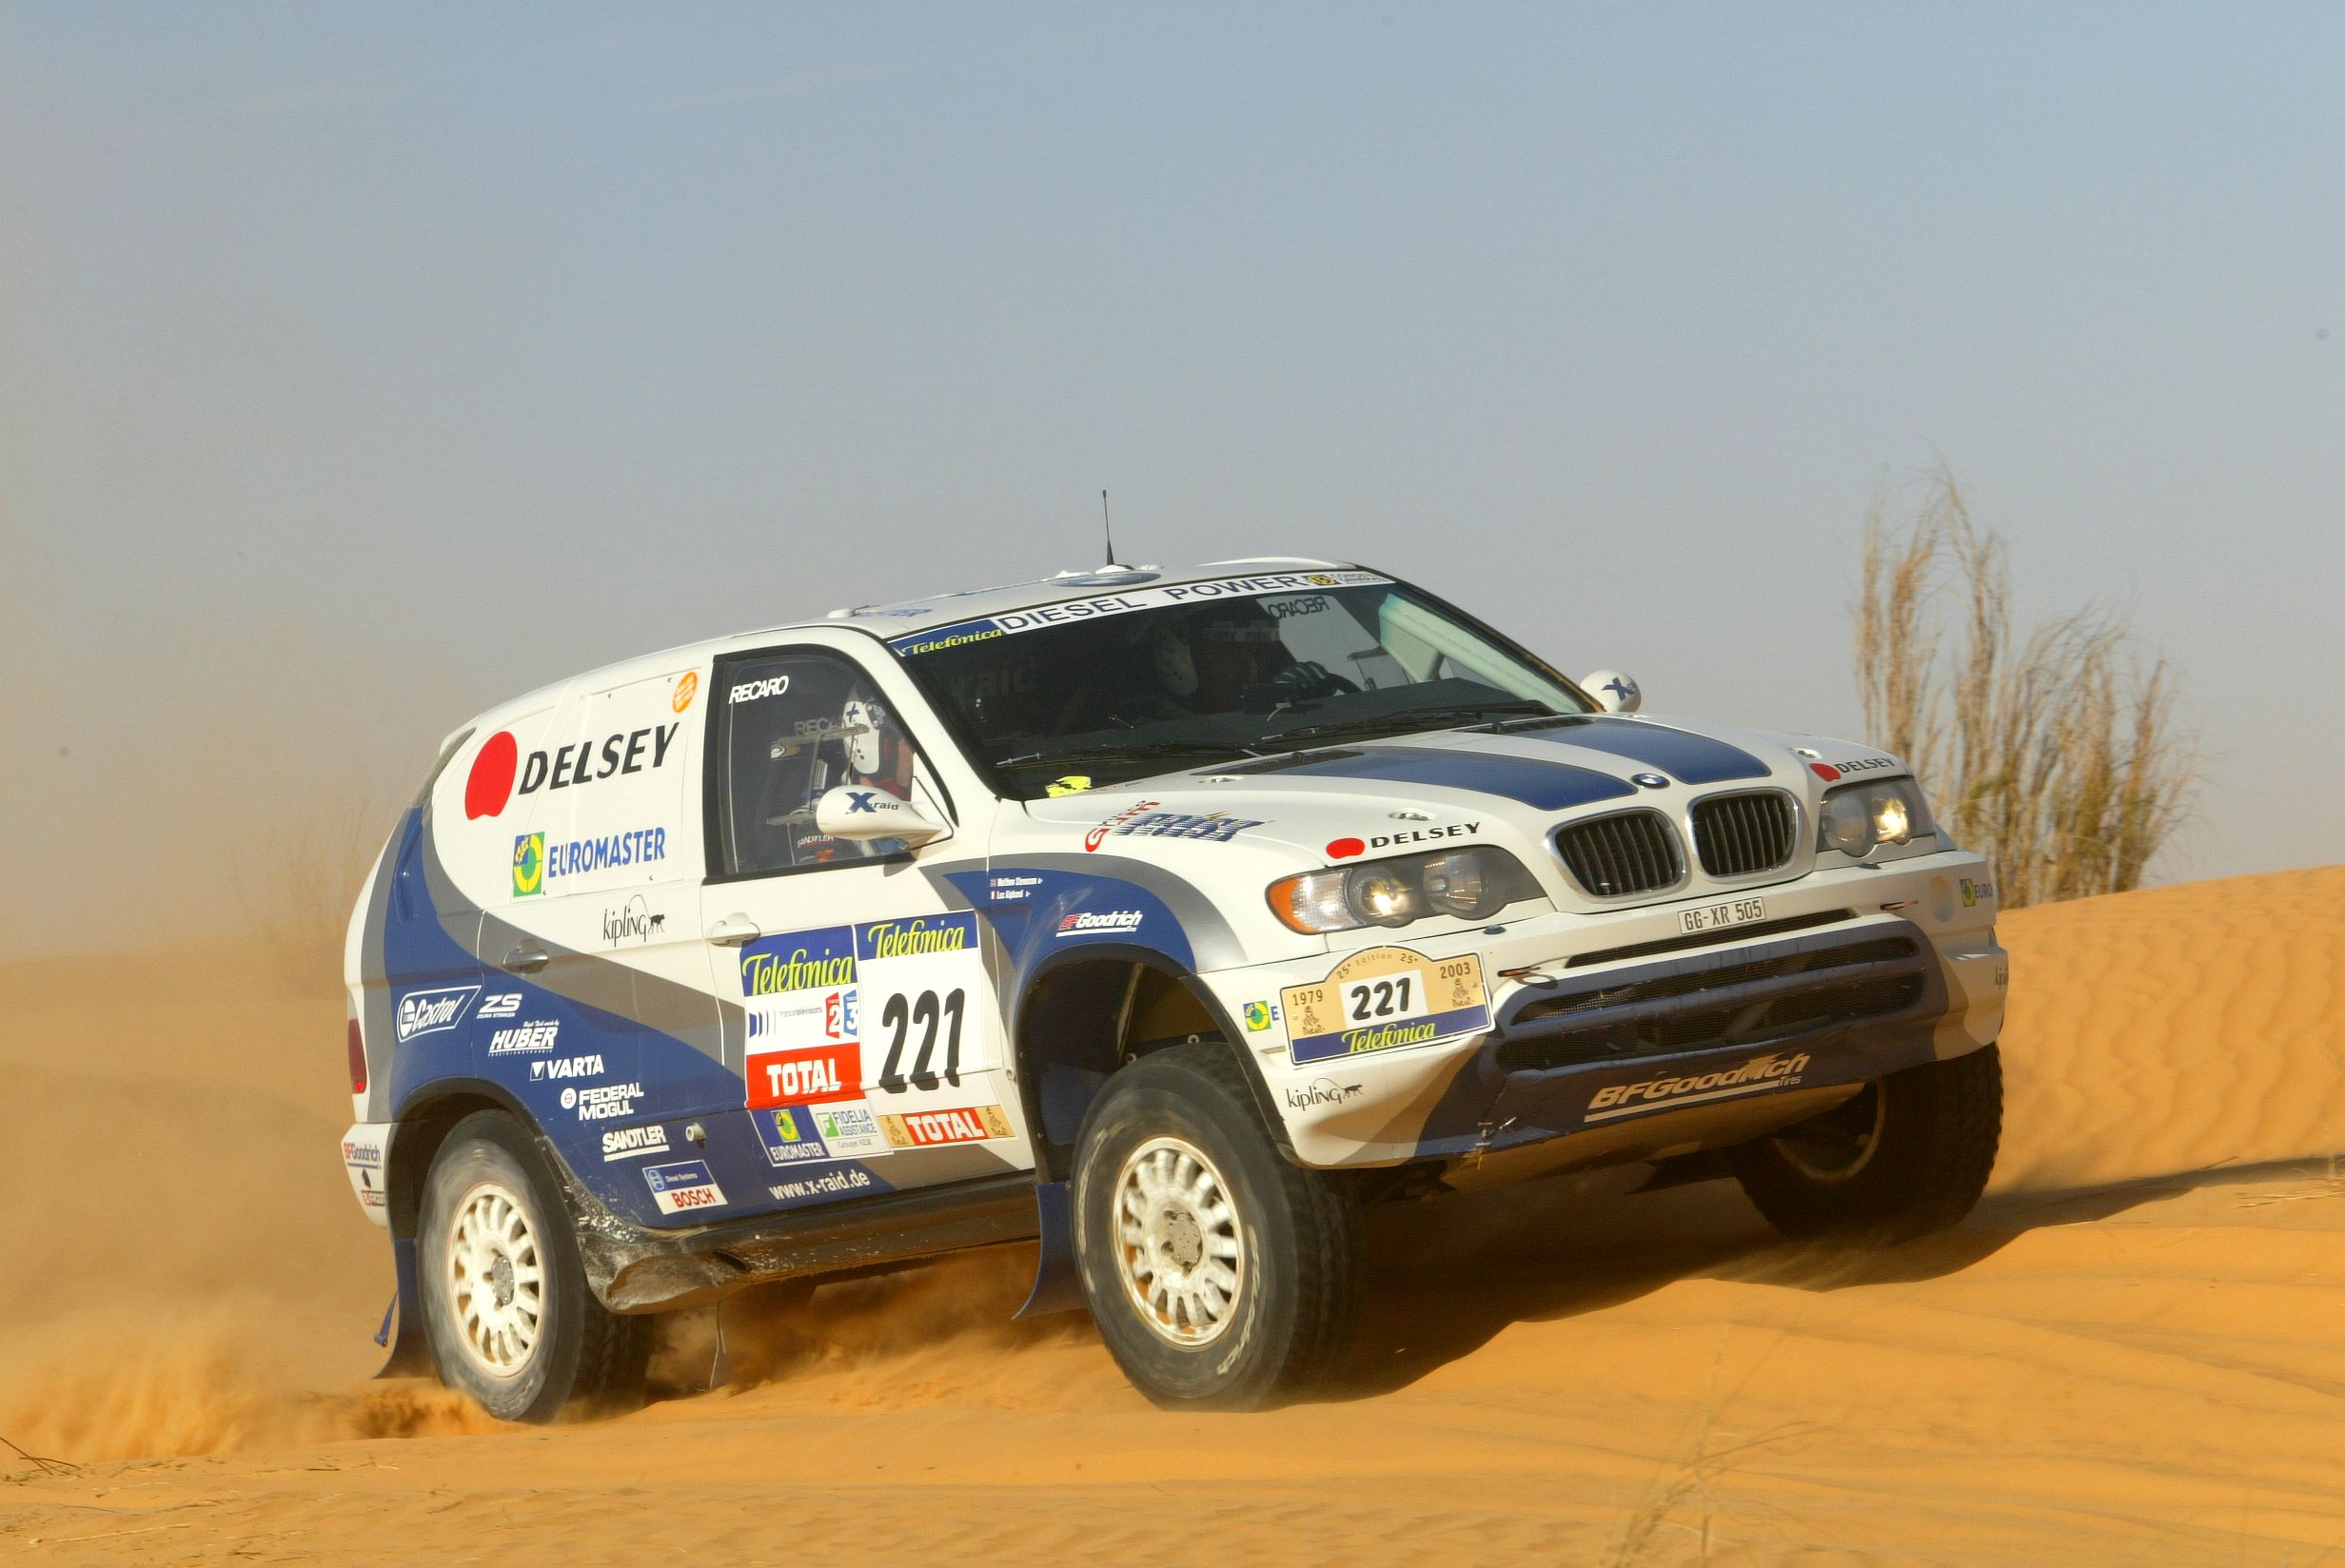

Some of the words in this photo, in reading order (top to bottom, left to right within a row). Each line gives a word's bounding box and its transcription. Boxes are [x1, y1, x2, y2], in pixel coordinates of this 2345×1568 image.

[999, 597, 1147, 631] DIESEL
[1162, 574, 1308, 601] POWER
[728, 676, 790, 705] RECARO
[518, 721, 680, 795] DELSEY
[1833, 756, 1897, 774] DELSEY
[1370, 821, 1481, 850] DELSEY
[548, 827, 666, 878] EUROMASTER
[1058, 910, 1143, 931] BFGoodrich
[1735, 899, 1762, 921] 505
[1439, 962, 1472, 980] 2003
[479, 992, 522, 1013] ZS
[1291, 989, 1325, 1007] 1979
[1350, 976, 1412, 1021] 221
[411, 993, 466, 1031] Castrol
[828, 1004, 841, 1033] 2
[846, 1002, 858, 1029] 3
[489, 1027, 559, 1052] HUBER
[878, 988, 965, 1094] 221
[546, 1054, 604, 1080] VARTA
[766, 1057, 842, 1098] TOTAL
[579, 1082, 644, 1104] FEDERAL
[1778, 1075, 1802, 1088] Tires
[578, 1104, 635, 1122] MOGUL
[833, 1108, 873, 1125] FIDELIA
[905, 1108, 986, 1144] TOTAL
[602, 1125, 667, 1154] SANDTLER
[769, 1141, 825, 1162] EUROMASTER
[769, 1168, 871, 1200] www.x-raid.de
[671, 1188, 716, 1208] BOSCH
